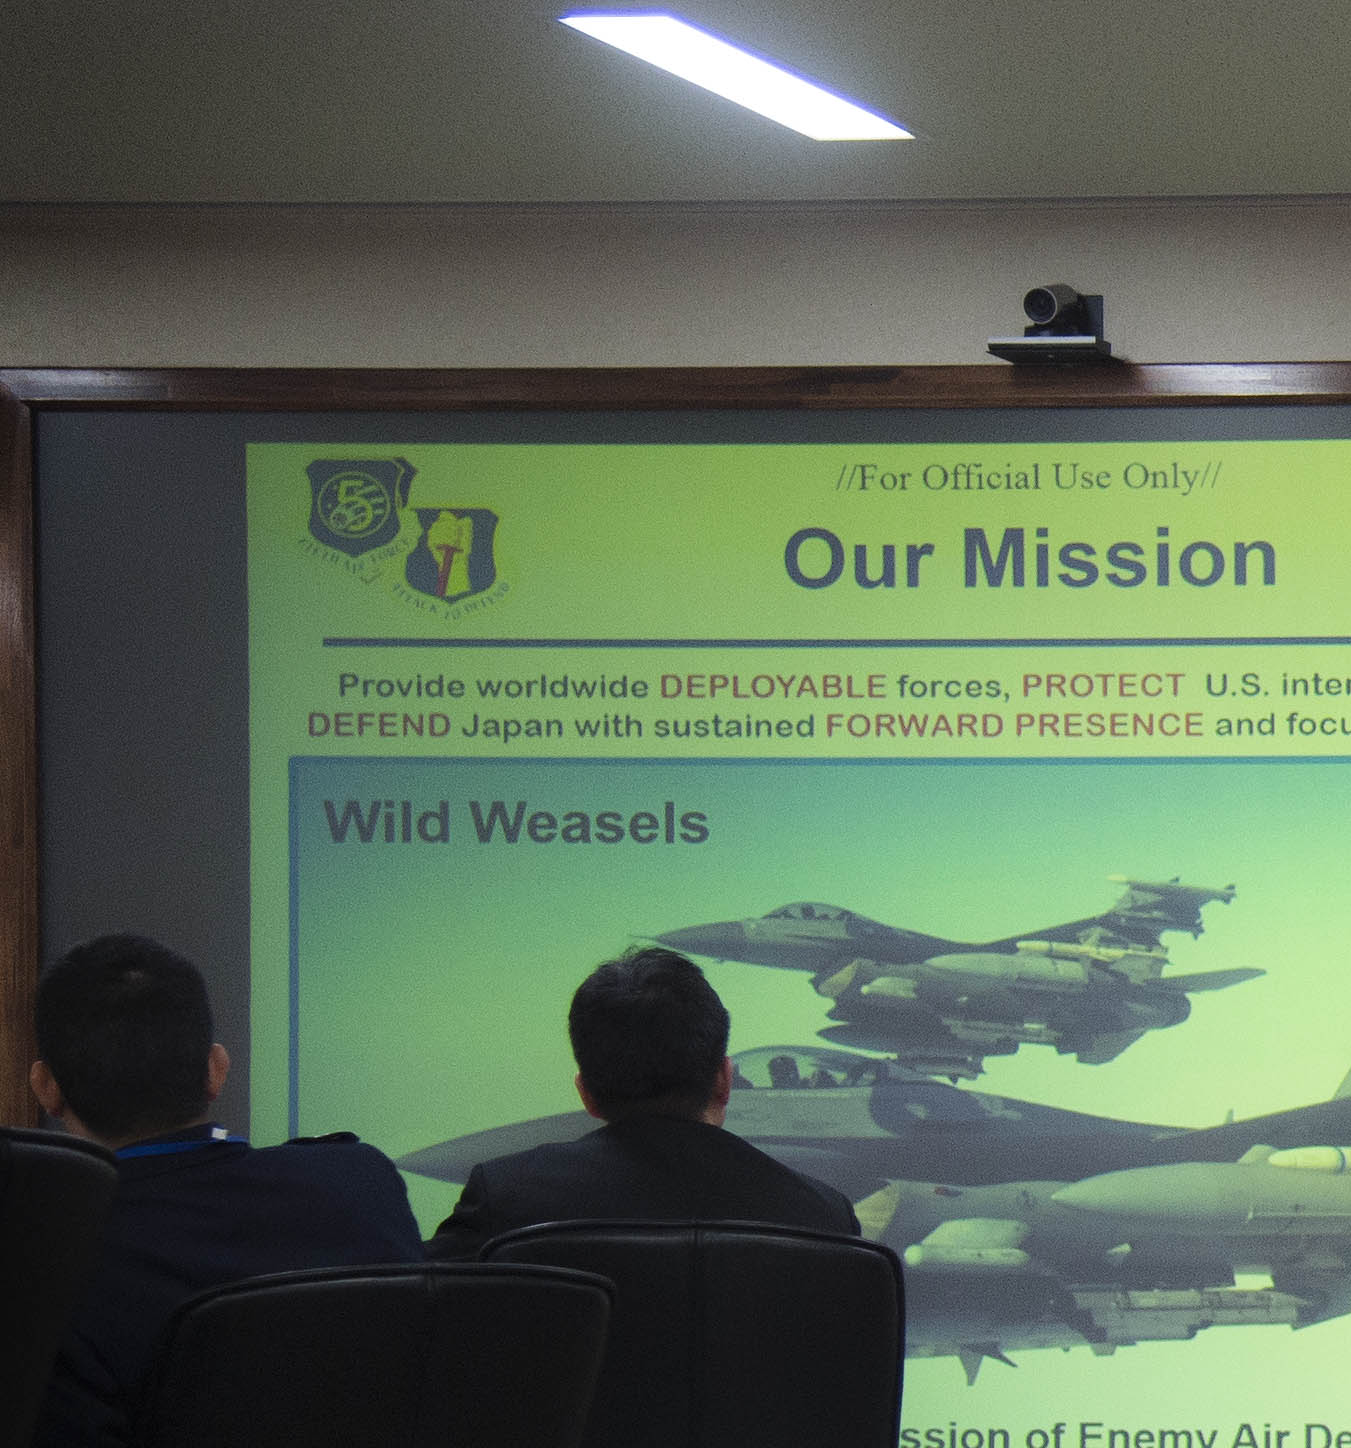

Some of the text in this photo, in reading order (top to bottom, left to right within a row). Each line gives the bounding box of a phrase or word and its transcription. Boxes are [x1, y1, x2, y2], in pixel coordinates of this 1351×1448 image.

[922, 462, 1040, 491] Official
[1053, 463, 1111, 490] Use
[783, 526, 1276, 590] Our Mission
[338, 672, 466, 699] Provide
[475, 673, 649, 699] worldwide
[660, 673, 887, 699] DEPLOYABLE
[896, 674, 1010, 702] forces,
[1022, 673, 1185, 698] PROTECT
[1206, 672, 1269, 697] U.S.
[307, 711, 452, 738] DEFEND
[461, 712, 564, 745] Japan
[574, 713, 643, 738] with
[654, 713, 815, 739] sustained
[826, 713, 1004, 739] FORWARD
[1015, 712, 1203, 738] PRESENCE
[1215, 711, 1276, 737] and
[323, 799, 710, 845] Wild Weasels
